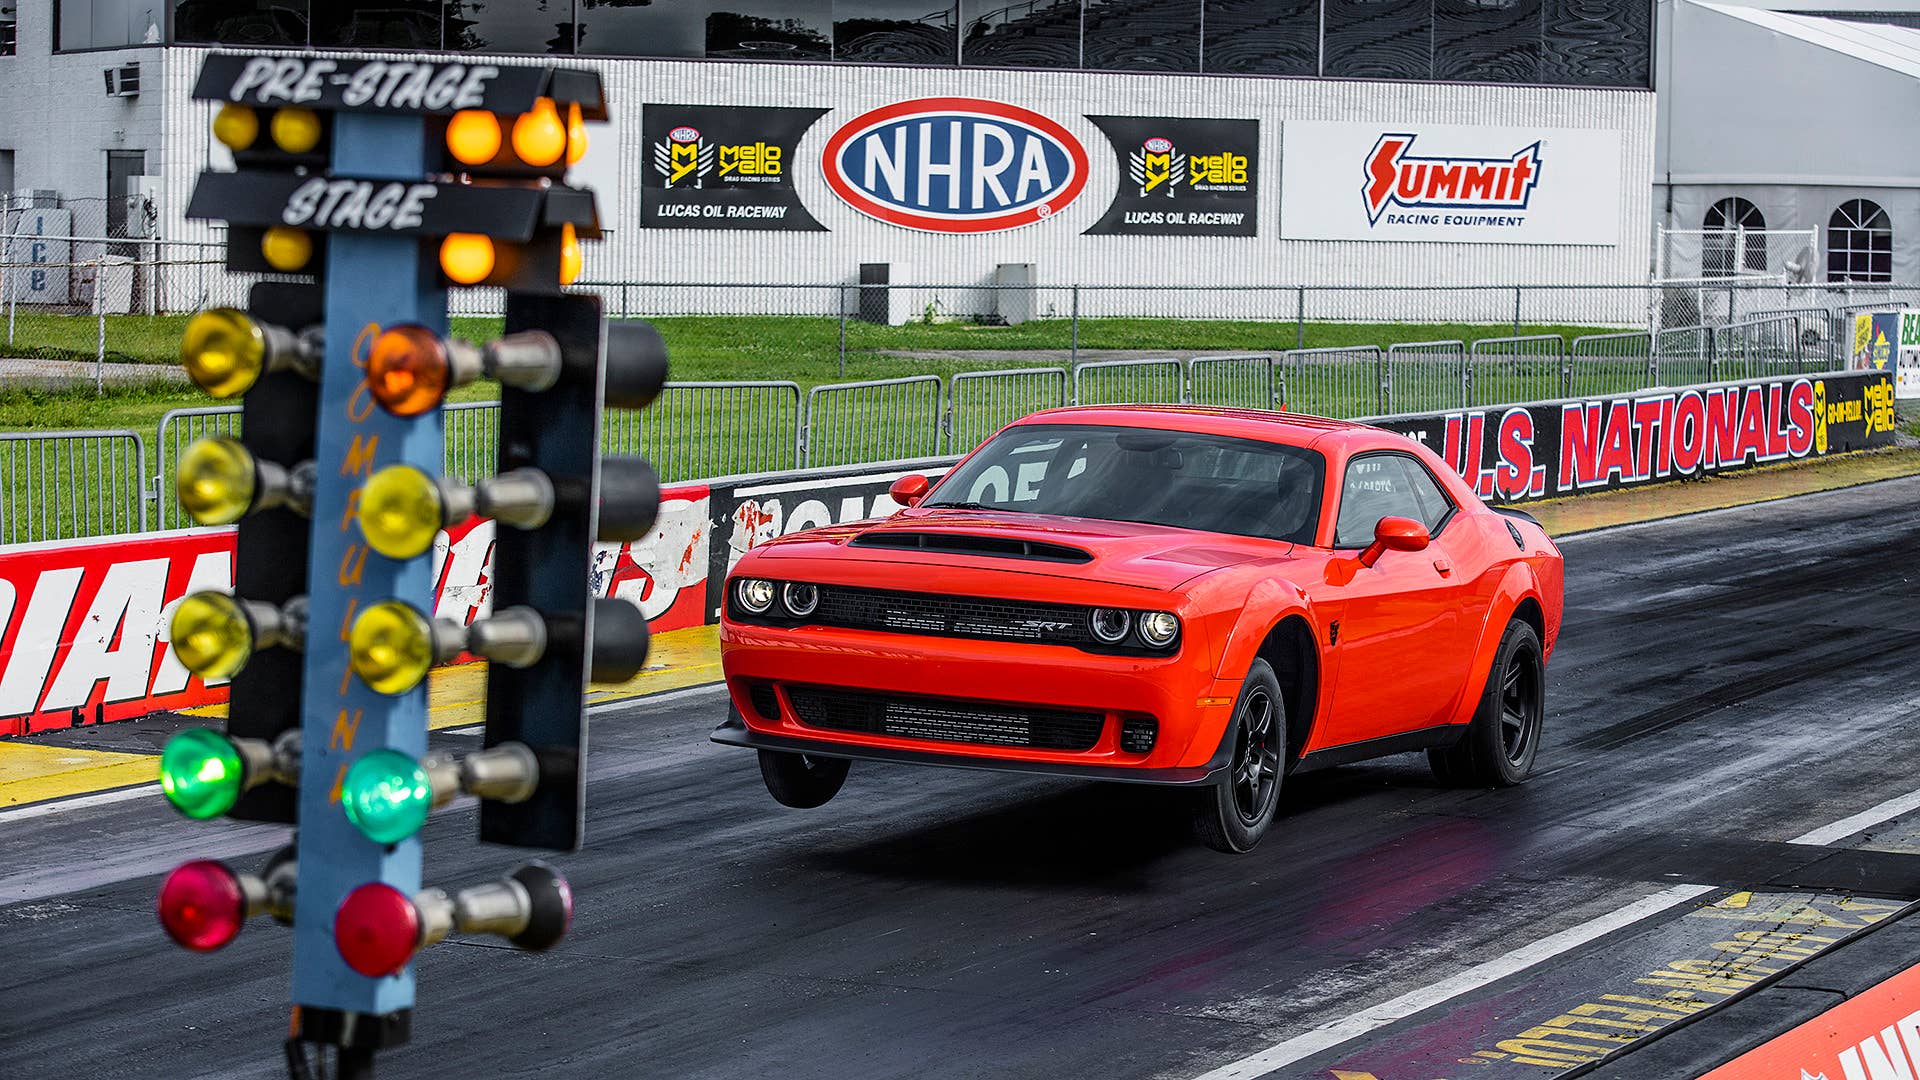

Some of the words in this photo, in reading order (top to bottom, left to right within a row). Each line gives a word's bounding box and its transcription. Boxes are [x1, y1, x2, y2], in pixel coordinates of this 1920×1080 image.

[229, 57, 499, 110] PRE-STAGE
[864, 121, 1052, 209] NHRA
[283, 177, 438, 230] STAGE
[658, 204, 700, 218] LUCAS
[702, 205, 725, 218] OIL
[726, 206, 787, 219] RACEWAY
[1124, 211, 1165, 224] LUCAS
[1166, 212, 1187, 225] OIL
[1188, 213, 1244, 225] RACEWAY
[1387, 214, 1439, 225] RACING
[1444, 215, 1525, 227] EQUIPMENT
[1443, 406, 1546, 501] U.S.
[1557, 379, 1815, 492] NATIONALS
[1022, 620, 1073, 632] SRT
